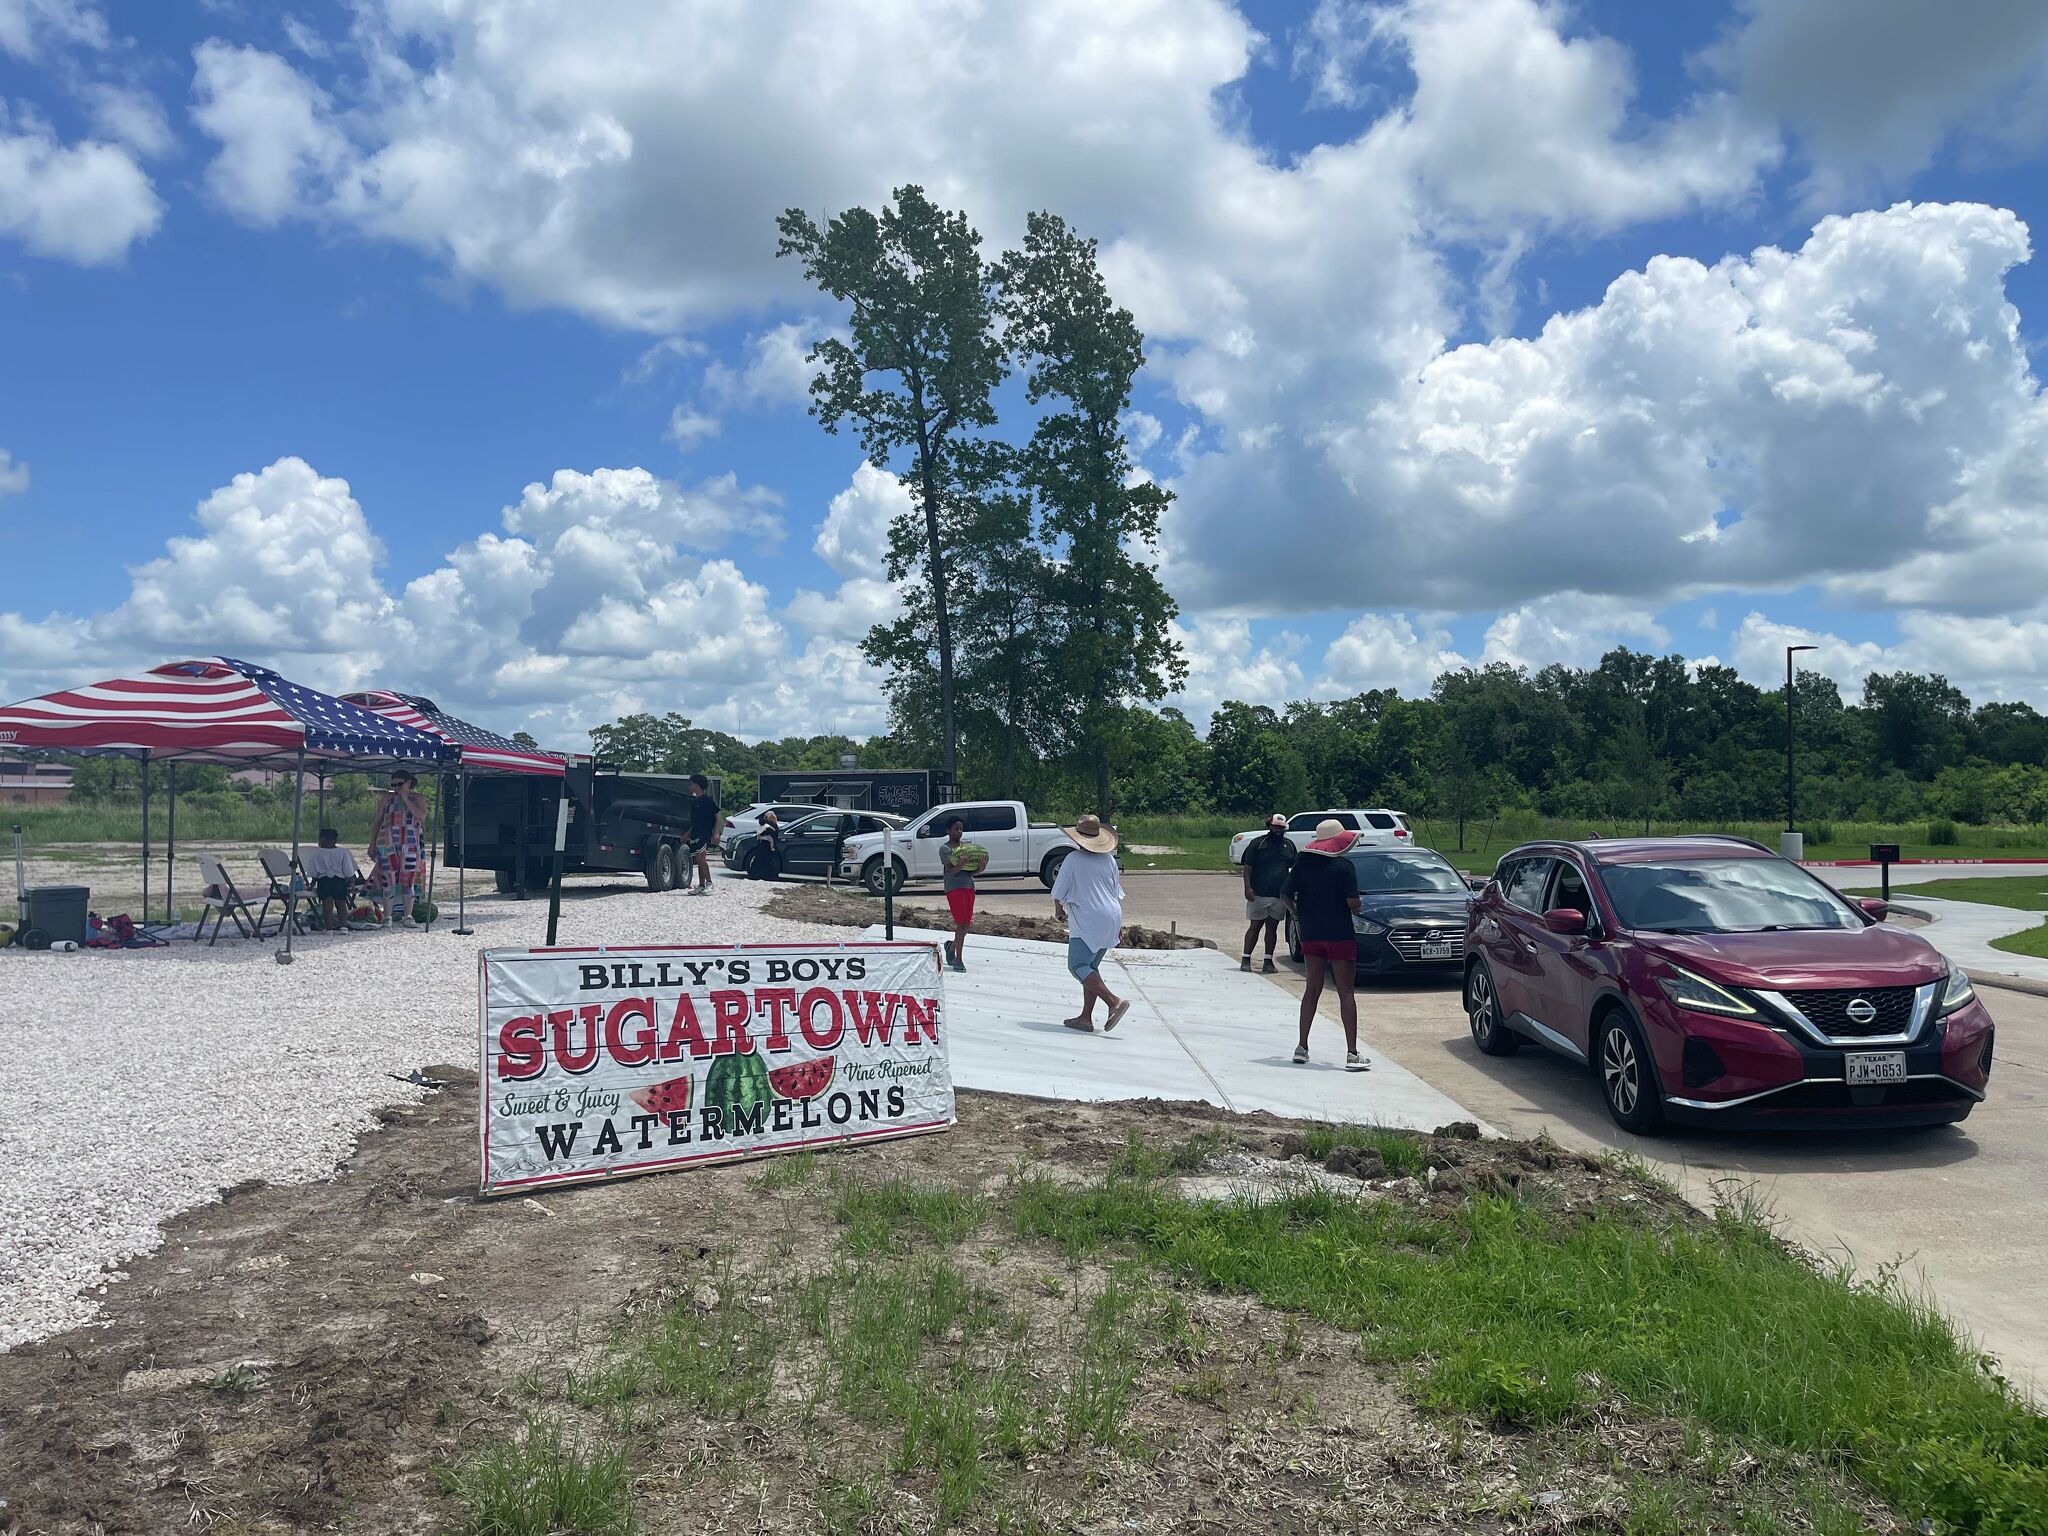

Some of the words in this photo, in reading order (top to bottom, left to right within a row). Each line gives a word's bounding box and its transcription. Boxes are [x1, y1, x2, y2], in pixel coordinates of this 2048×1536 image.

[879, 785, 918, 795] SMASH
[579, 959, 751, 990] BILLY'S
[766, 957, 866, 983] BOYS
[497, 986, 940, 1083] SUGARTOWN
[843, 1061, 876, 1083] Vine
[877, 1055, 933, 1084] Ripened
[499, 1092, 551, 1117] Sweet
[555, 1087, 570, 1112] &
[575, 1086, 621, 1118] Juicy
[535, 1085, 905, 1162] WATERMELONS
